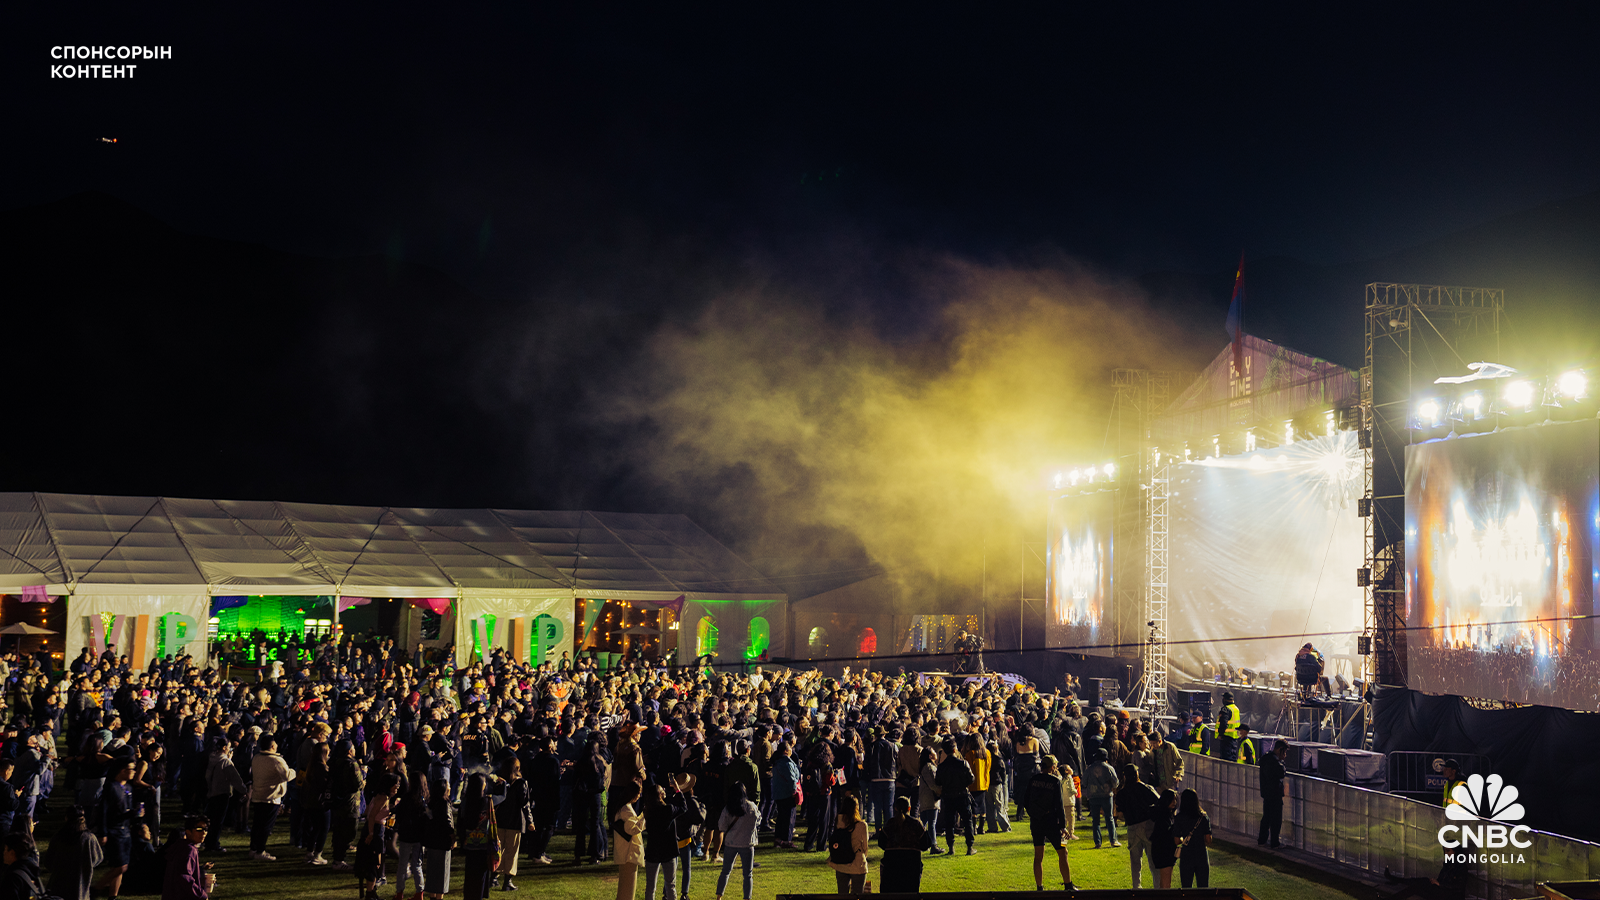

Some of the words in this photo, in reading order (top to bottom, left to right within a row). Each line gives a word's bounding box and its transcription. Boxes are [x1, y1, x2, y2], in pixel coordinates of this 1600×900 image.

[1230, 376, 1251, 399] TIME
[91, 614, 198, 669] VIP
[476, 617, 564, 668] VIP
[1427, 778, 1448, 786] POLIC
